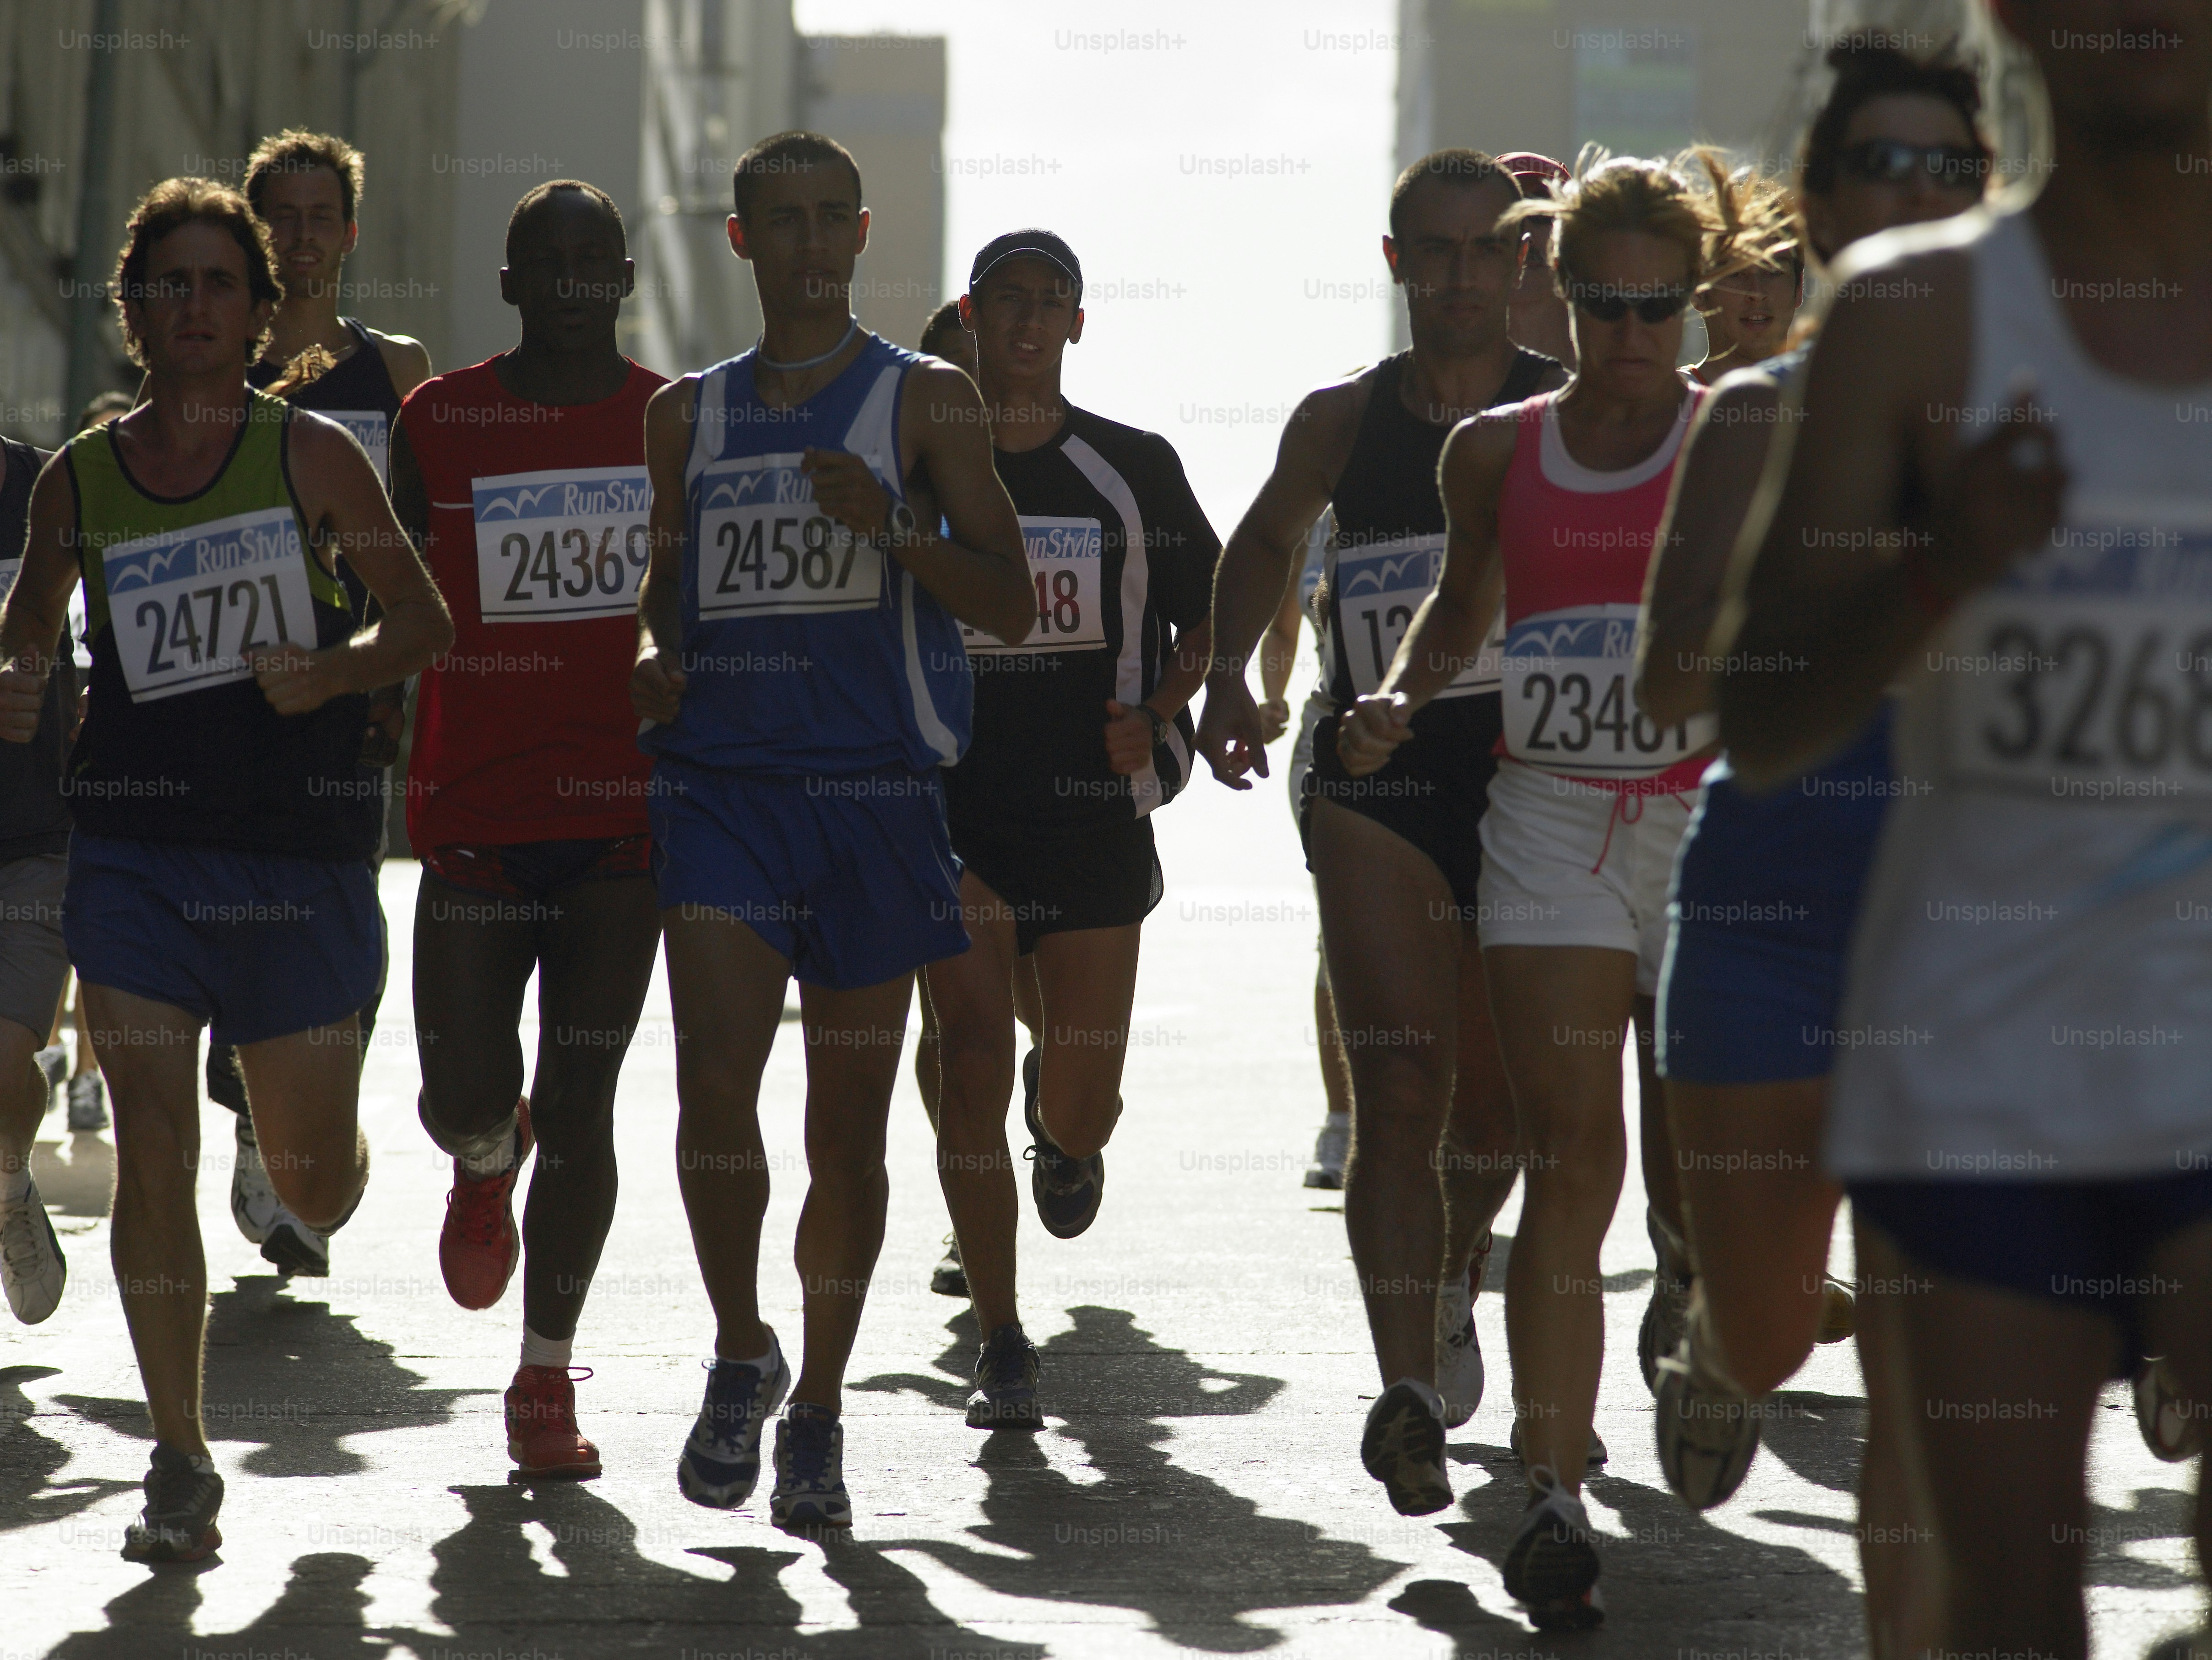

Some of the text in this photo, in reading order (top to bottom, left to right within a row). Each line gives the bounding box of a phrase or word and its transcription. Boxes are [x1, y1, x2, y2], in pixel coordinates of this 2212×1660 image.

[346, 420, 386, 446] Style
[564, 477, 654, 516] RunStyl
[196, 519, 301, 575] RunStyle
[501, 524, 651, 601] 24369
[716, 516, 857, 594] 24587
[1023, 527, 1100, 558] unStyle
[136, 574, 288, 674] 24721
